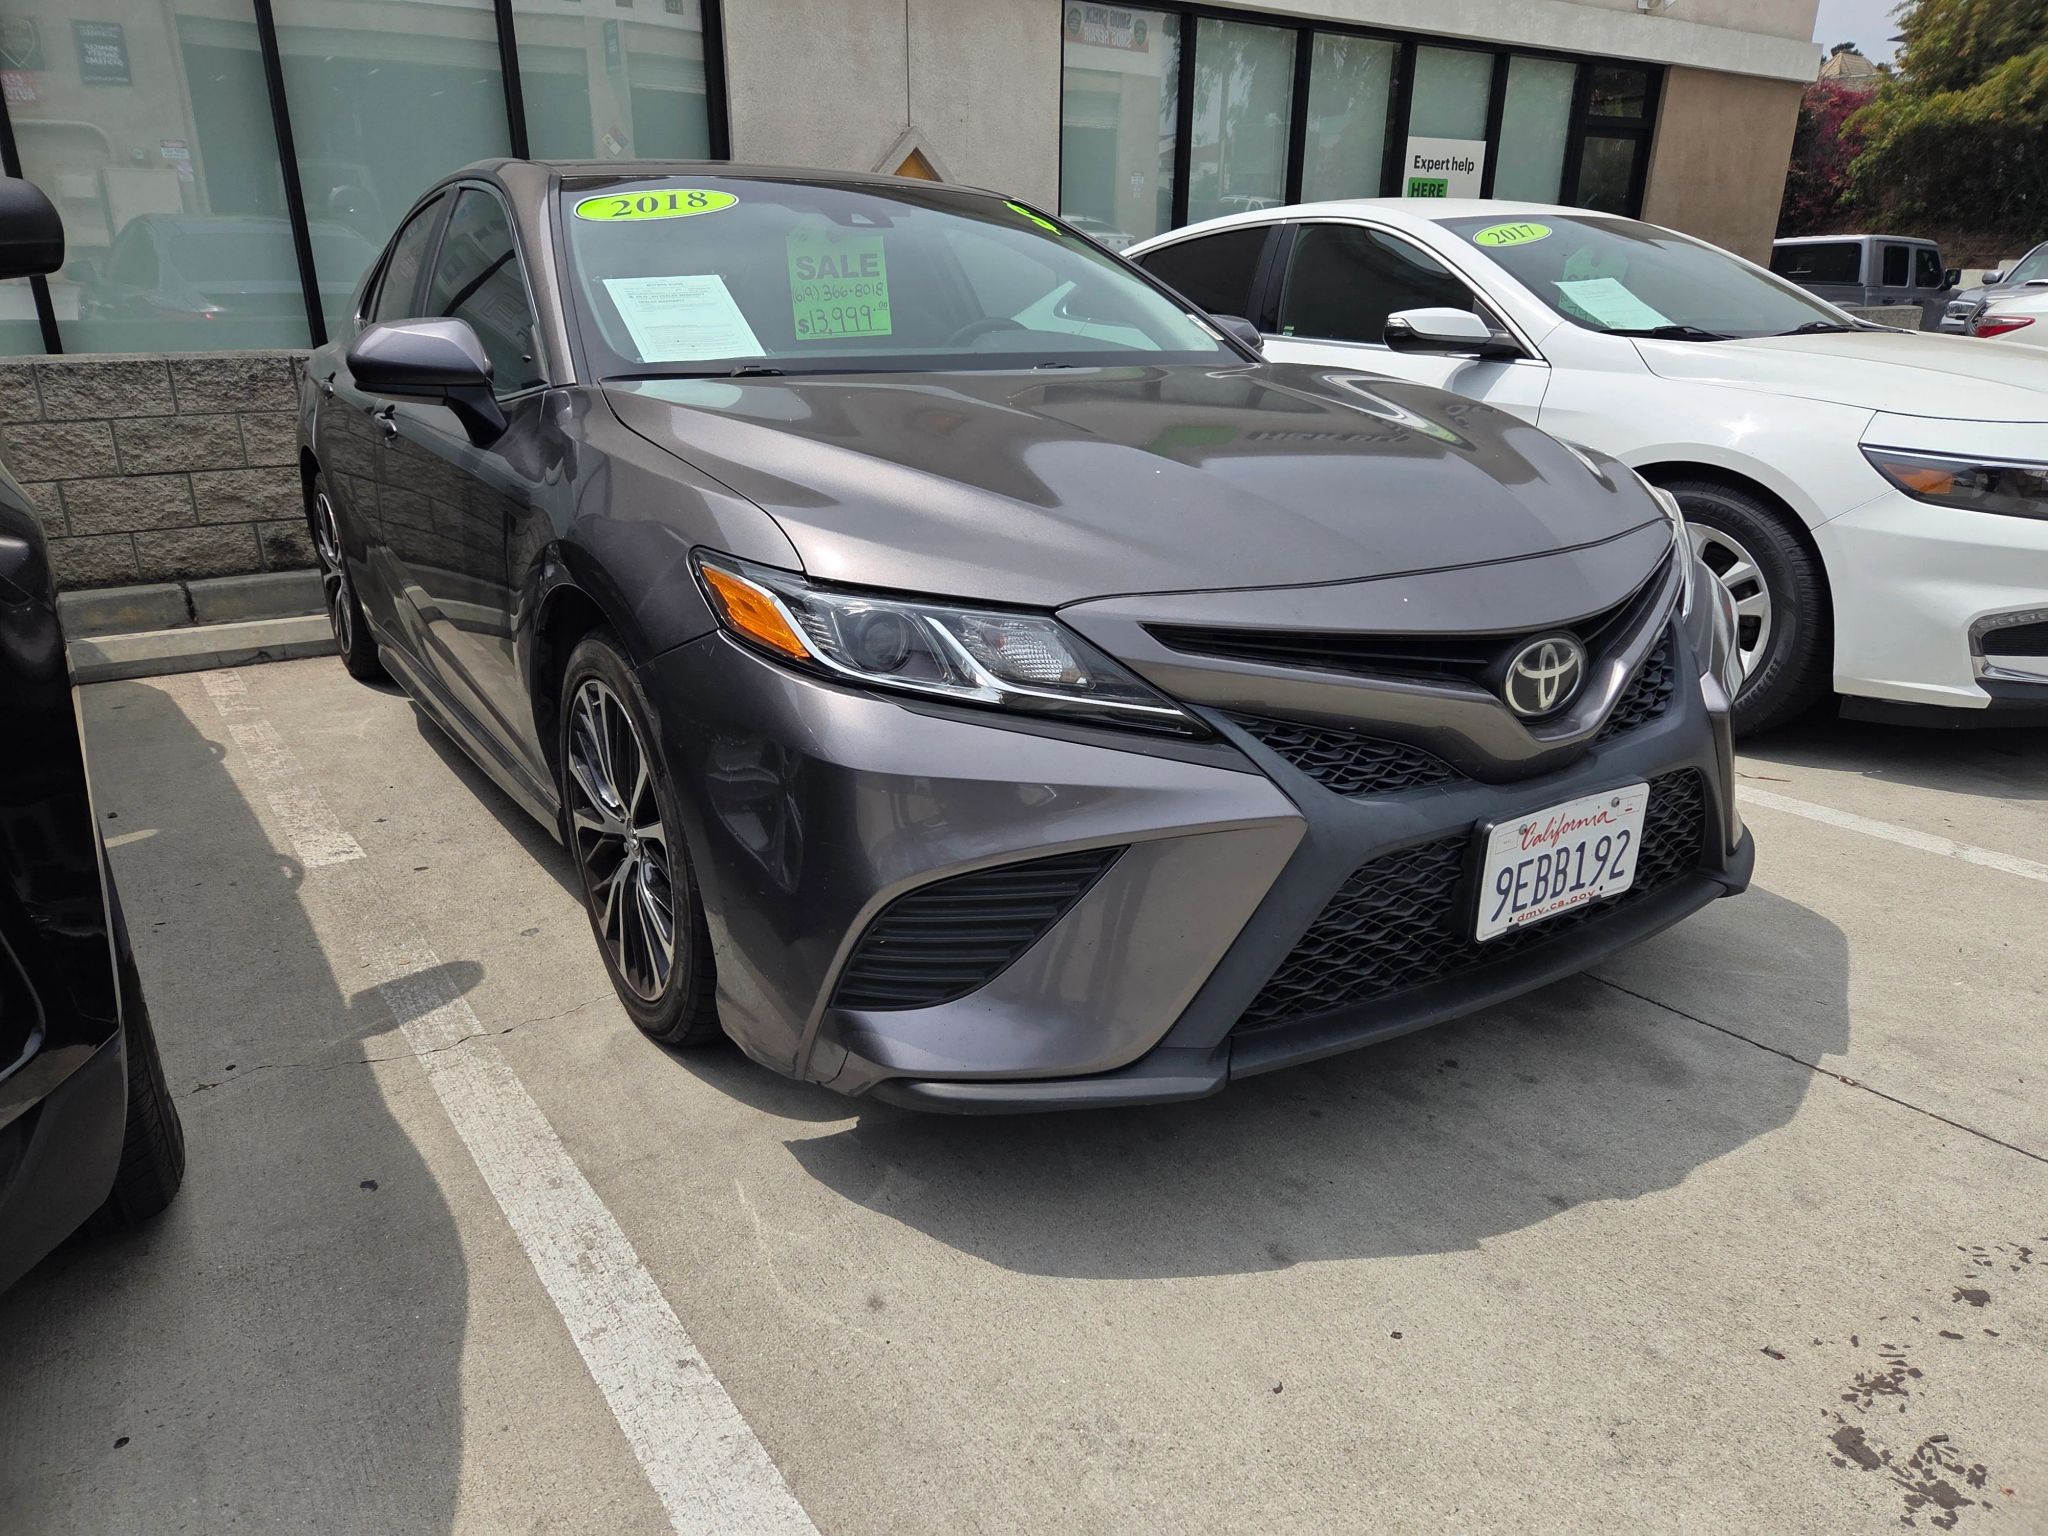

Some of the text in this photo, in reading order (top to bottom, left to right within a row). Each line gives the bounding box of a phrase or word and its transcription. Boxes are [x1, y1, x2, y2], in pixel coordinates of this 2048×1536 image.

[1413, 154, 1475, 175] Expert help
[1410, 182, 1444, 198] HERE
[610, 192, 708, 217] 2018
[1487, 224, 1535, 244] 2017
[796, 253, 881, 281] SALE
[792, 284, 820, 304] (619)
[1521, 810, 1617, 851] California
[1490, 829, 1631, 922] 9EBB192
[1517, 889, 1597, 923] dmv.ca.gov
